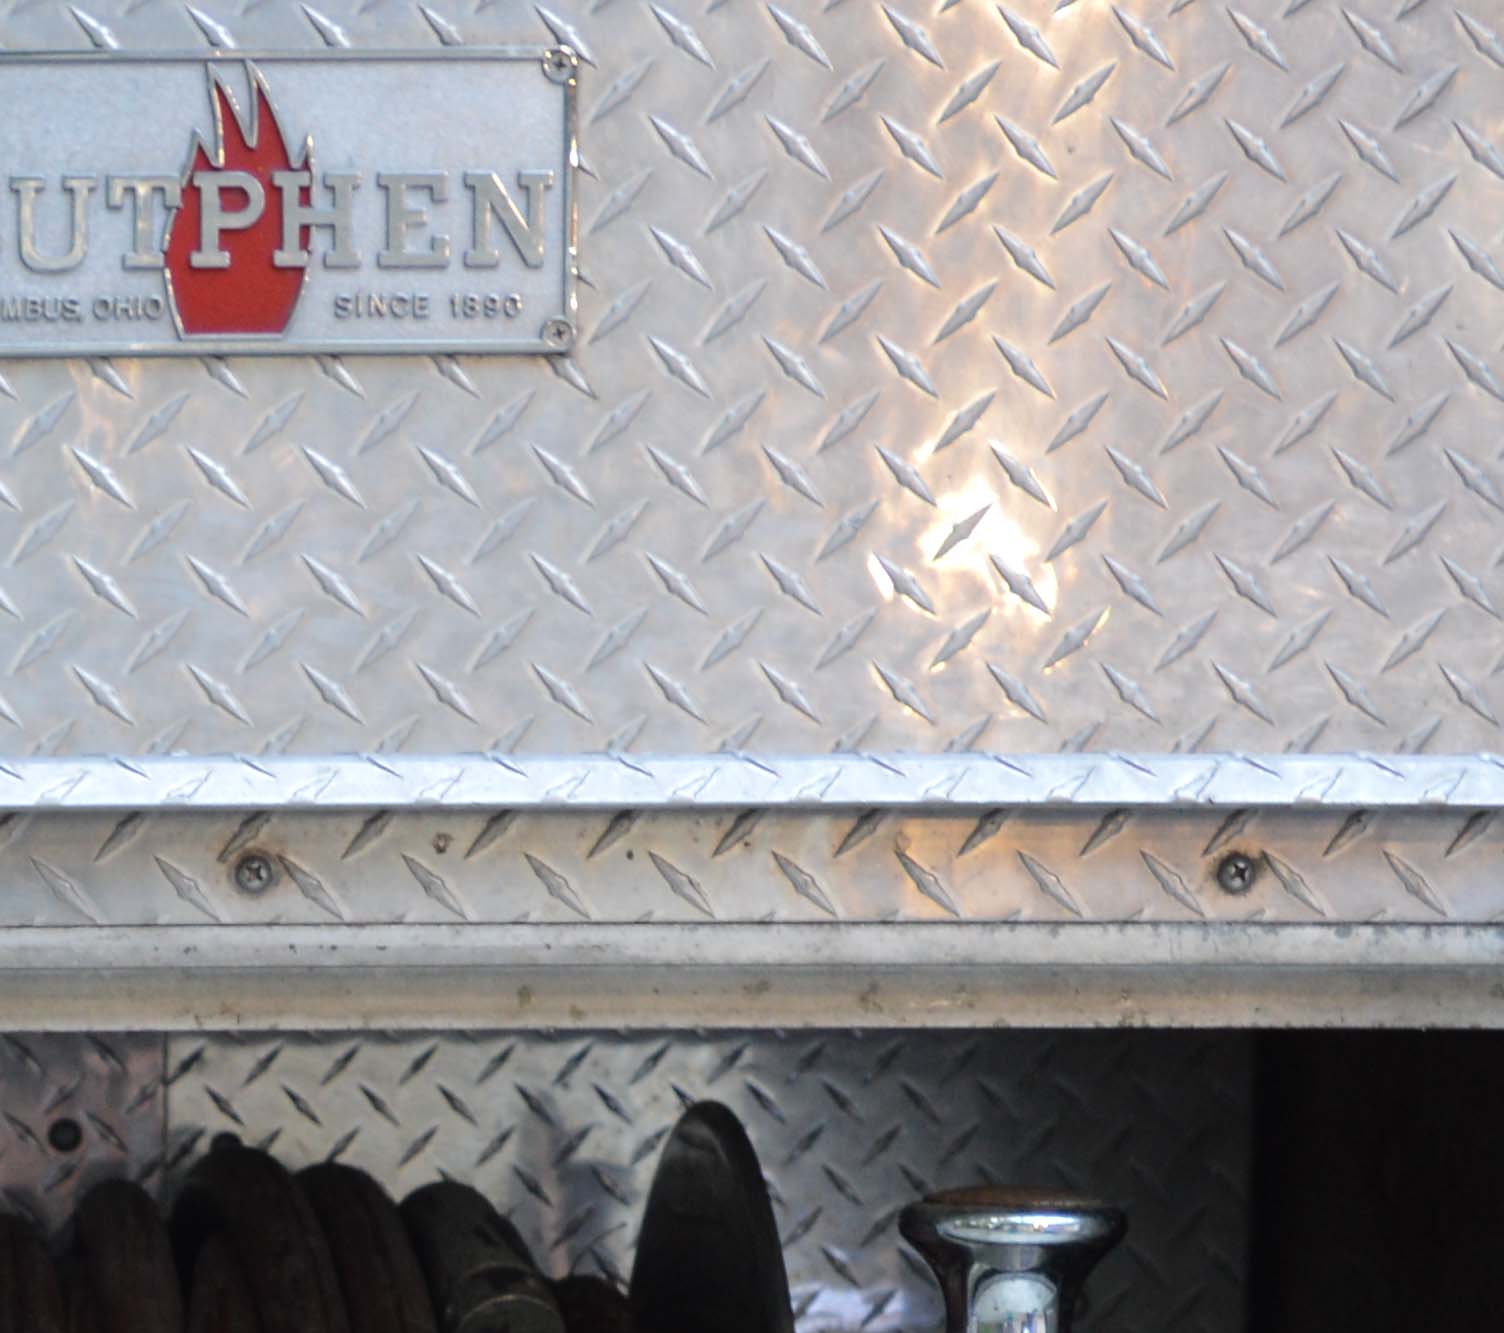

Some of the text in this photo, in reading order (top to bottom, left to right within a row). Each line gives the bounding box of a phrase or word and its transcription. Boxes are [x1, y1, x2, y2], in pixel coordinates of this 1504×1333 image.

[93, 298, 165, 322] OHIO
[334, 294, 523, 320] SINCE 1890
